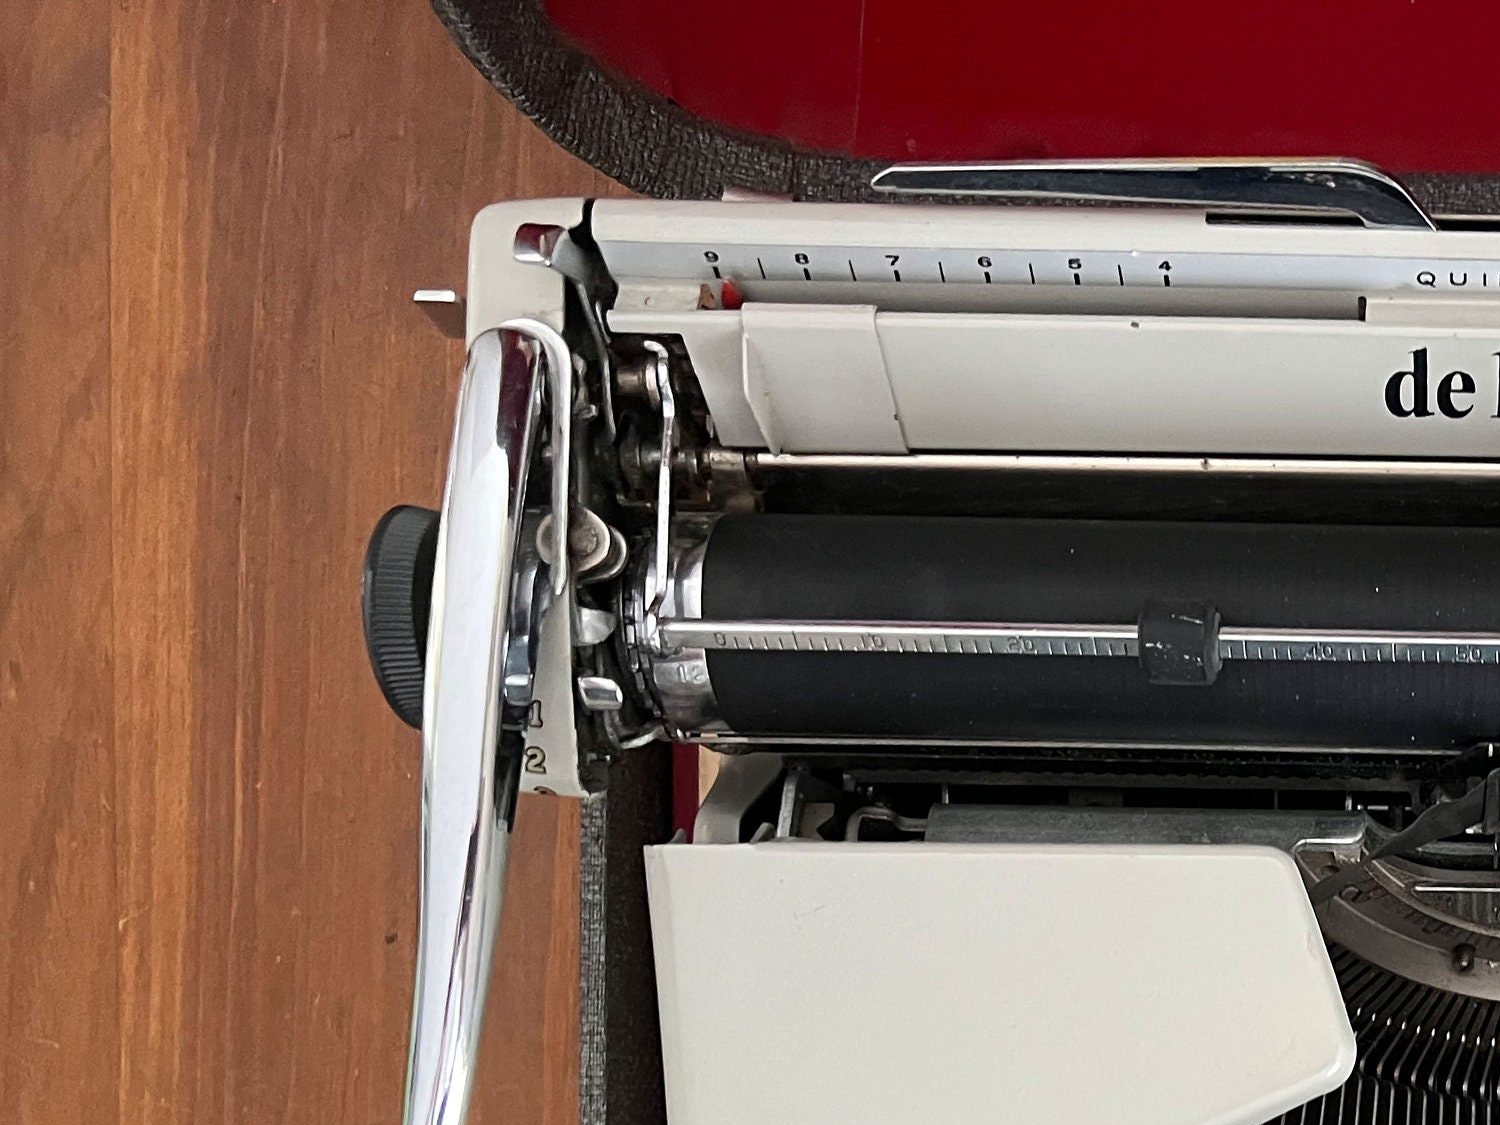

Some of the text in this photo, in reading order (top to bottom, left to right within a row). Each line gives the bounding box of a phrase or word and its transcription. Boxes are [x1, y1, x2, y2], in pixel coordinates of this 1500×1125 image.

[704, 251, 1172, 271] 9 8 7 6 5 4
[1385, 348, 1475, 418] de
[529, 700, 544, 728] 1
[525, 746, 546, 774] 2
